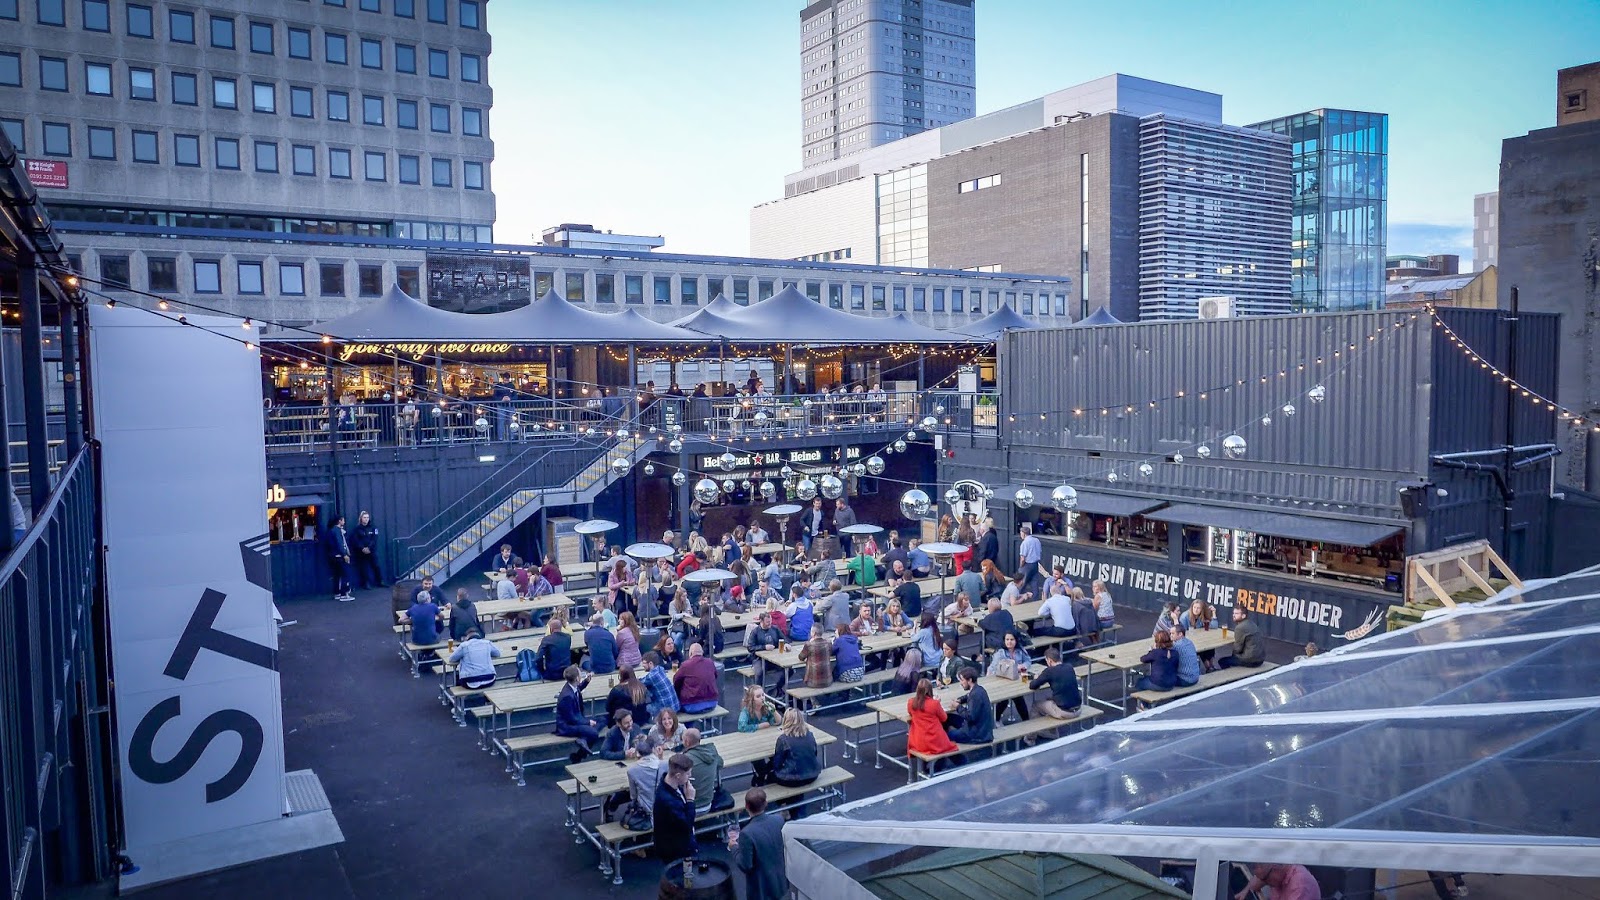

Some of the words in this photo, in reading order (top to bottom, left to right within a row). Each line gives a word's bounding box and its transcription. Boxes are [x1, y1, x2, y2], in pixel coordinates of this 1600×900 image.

[340, 344, 383, 361] you
[470, 343, 511, 353] once
[703, 454, 751, 468] Heiken
[765, 453, 780, 464] BAR
[790, 450, 821, 462] Heinek
[846, 447, 860, 459] BAR
[1098, 562, 1110, 582] IS
[1110, 565, 1125, 586] IN
[1129, 568, 1154, 592] THE
[1154, 572, 1180, 597] EYE
[1183, 578, 1202, 600] OF
[1206, 582, 1234, 608] THE
[1236, 588, 1343, 629] BEERHOLDER
